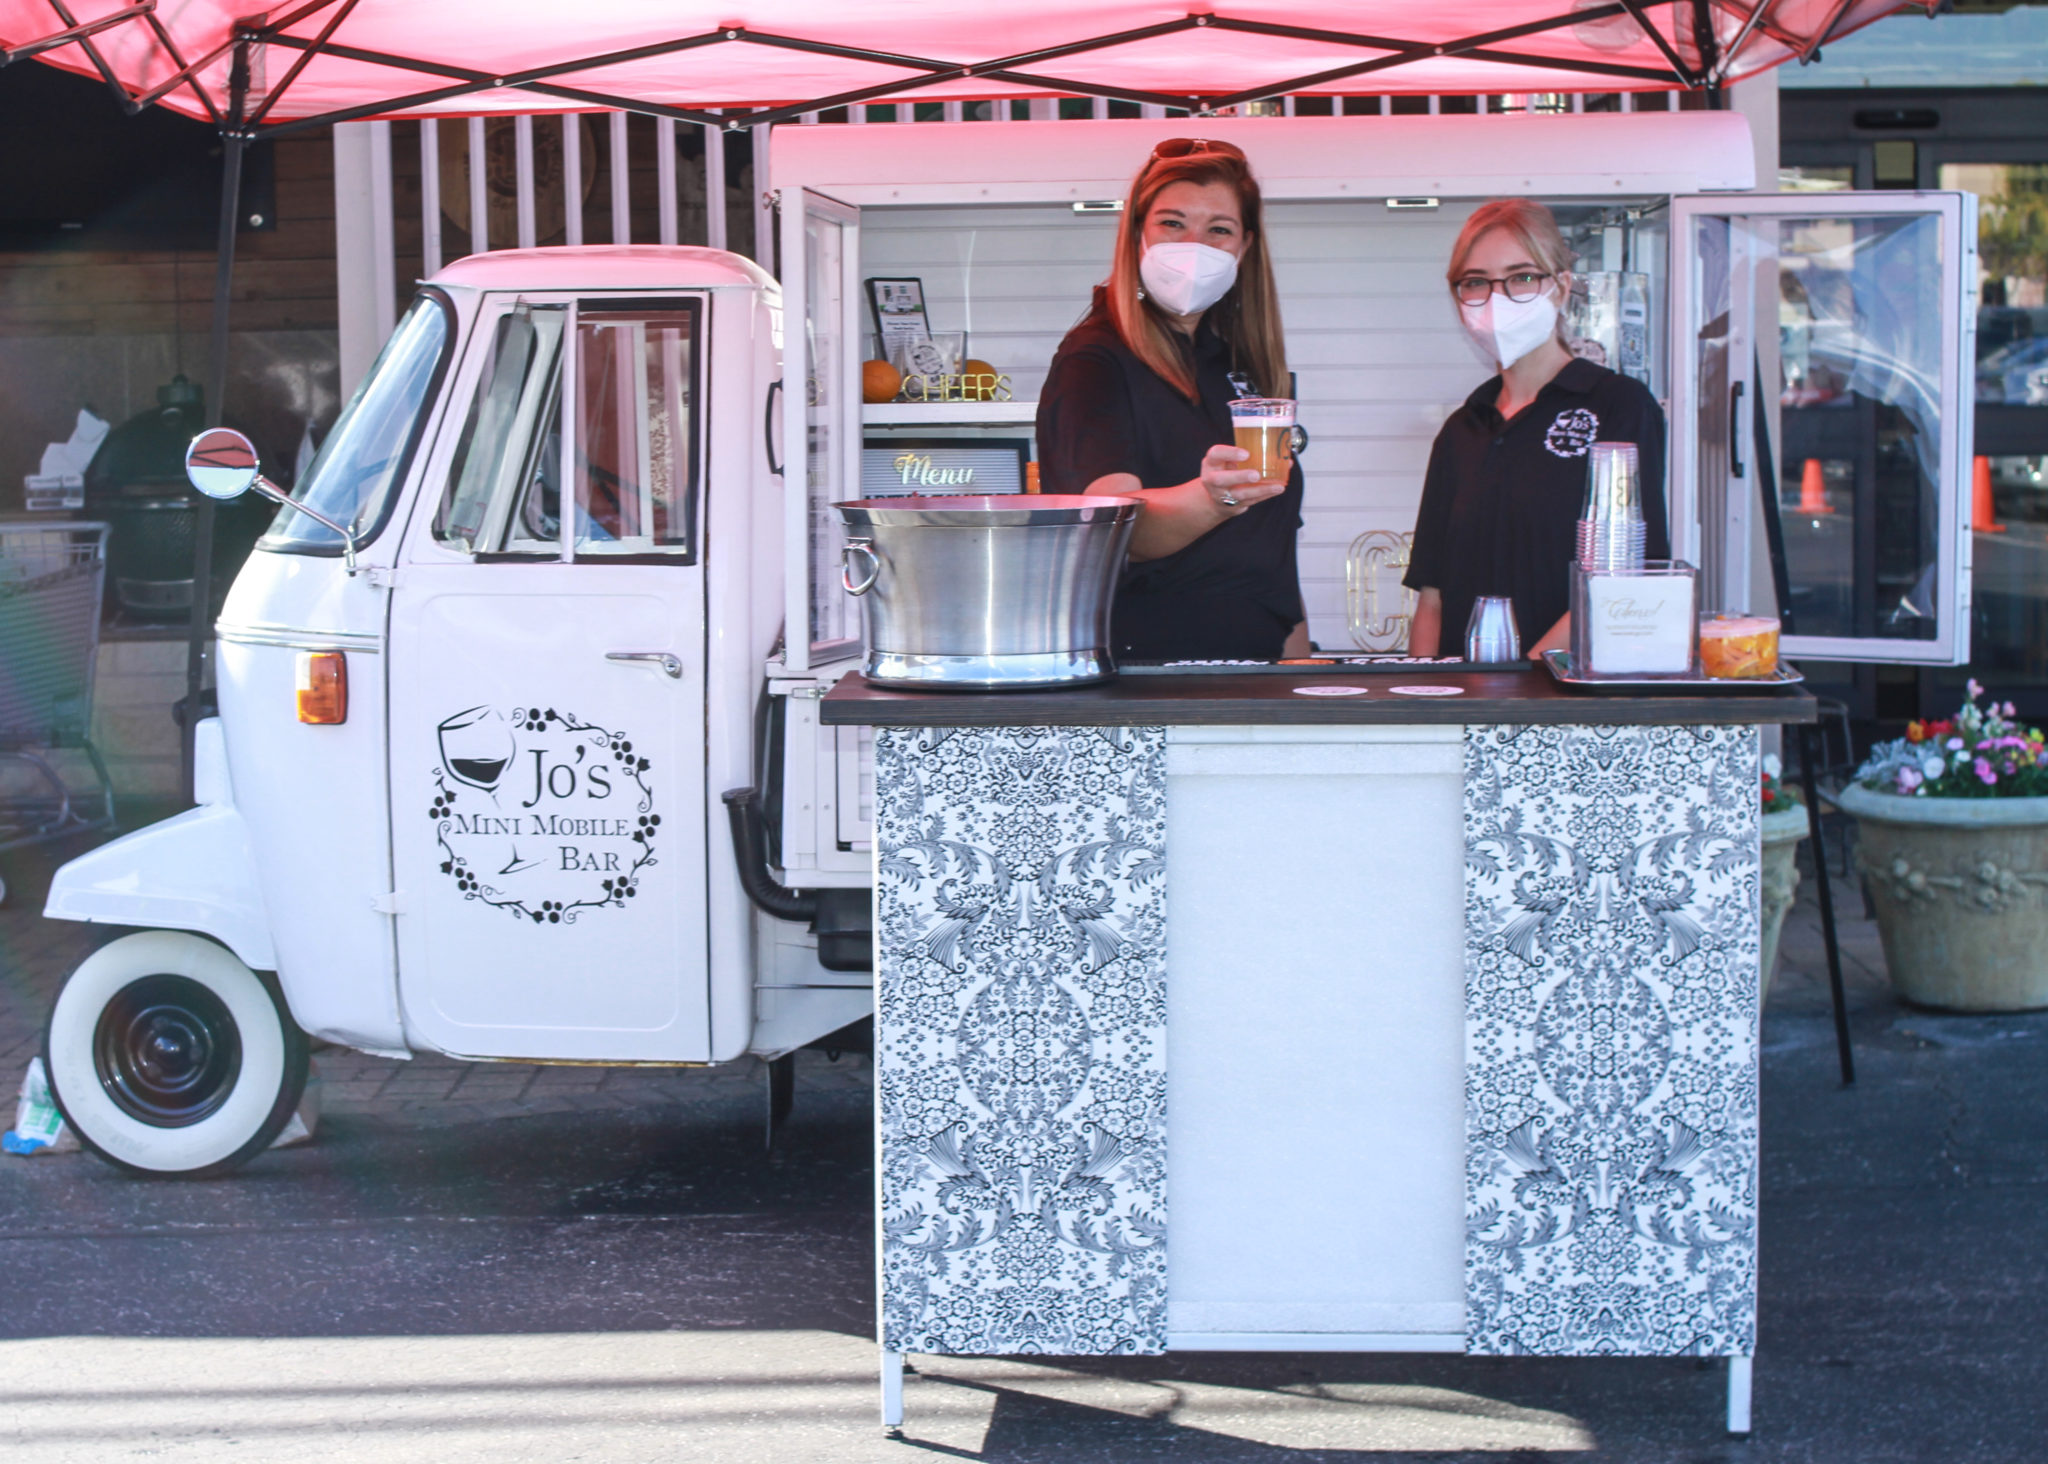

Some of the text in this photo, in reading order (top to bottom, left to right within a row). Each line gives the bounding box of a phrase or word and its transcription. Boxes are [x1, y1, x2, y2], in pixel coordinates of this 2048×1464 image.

[901, 373, 1013, 402] CHEERS
[893, 452, 976, 486] Menu
[453, 813, 630, 837] MINI MOBILE
[558, 845, 621, 872] BAR
